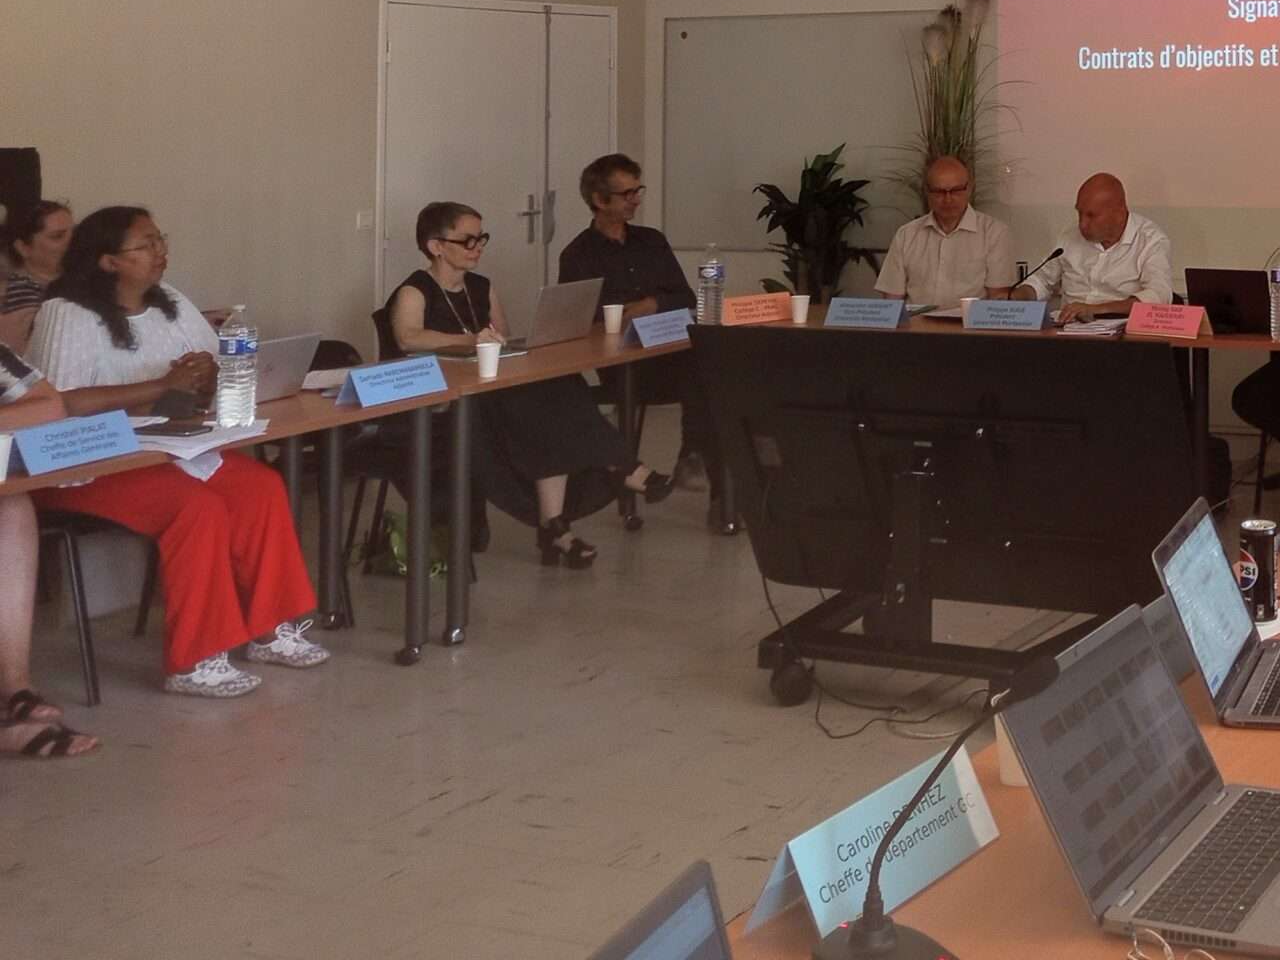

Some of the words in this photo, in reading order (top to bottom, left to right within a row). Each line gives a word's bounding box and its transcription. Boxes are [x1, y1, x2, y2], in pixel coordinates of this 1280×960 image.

[1078, 46, 1154, 70] Contrats
[1159, 43, 1255, 72] d'objectifs
[1259, 43, 1280, 67] et
[818, 867, 864, 905] Cheffe
[885, 809, 958, 864] département
[836, 818, 891, 864] Caroline
